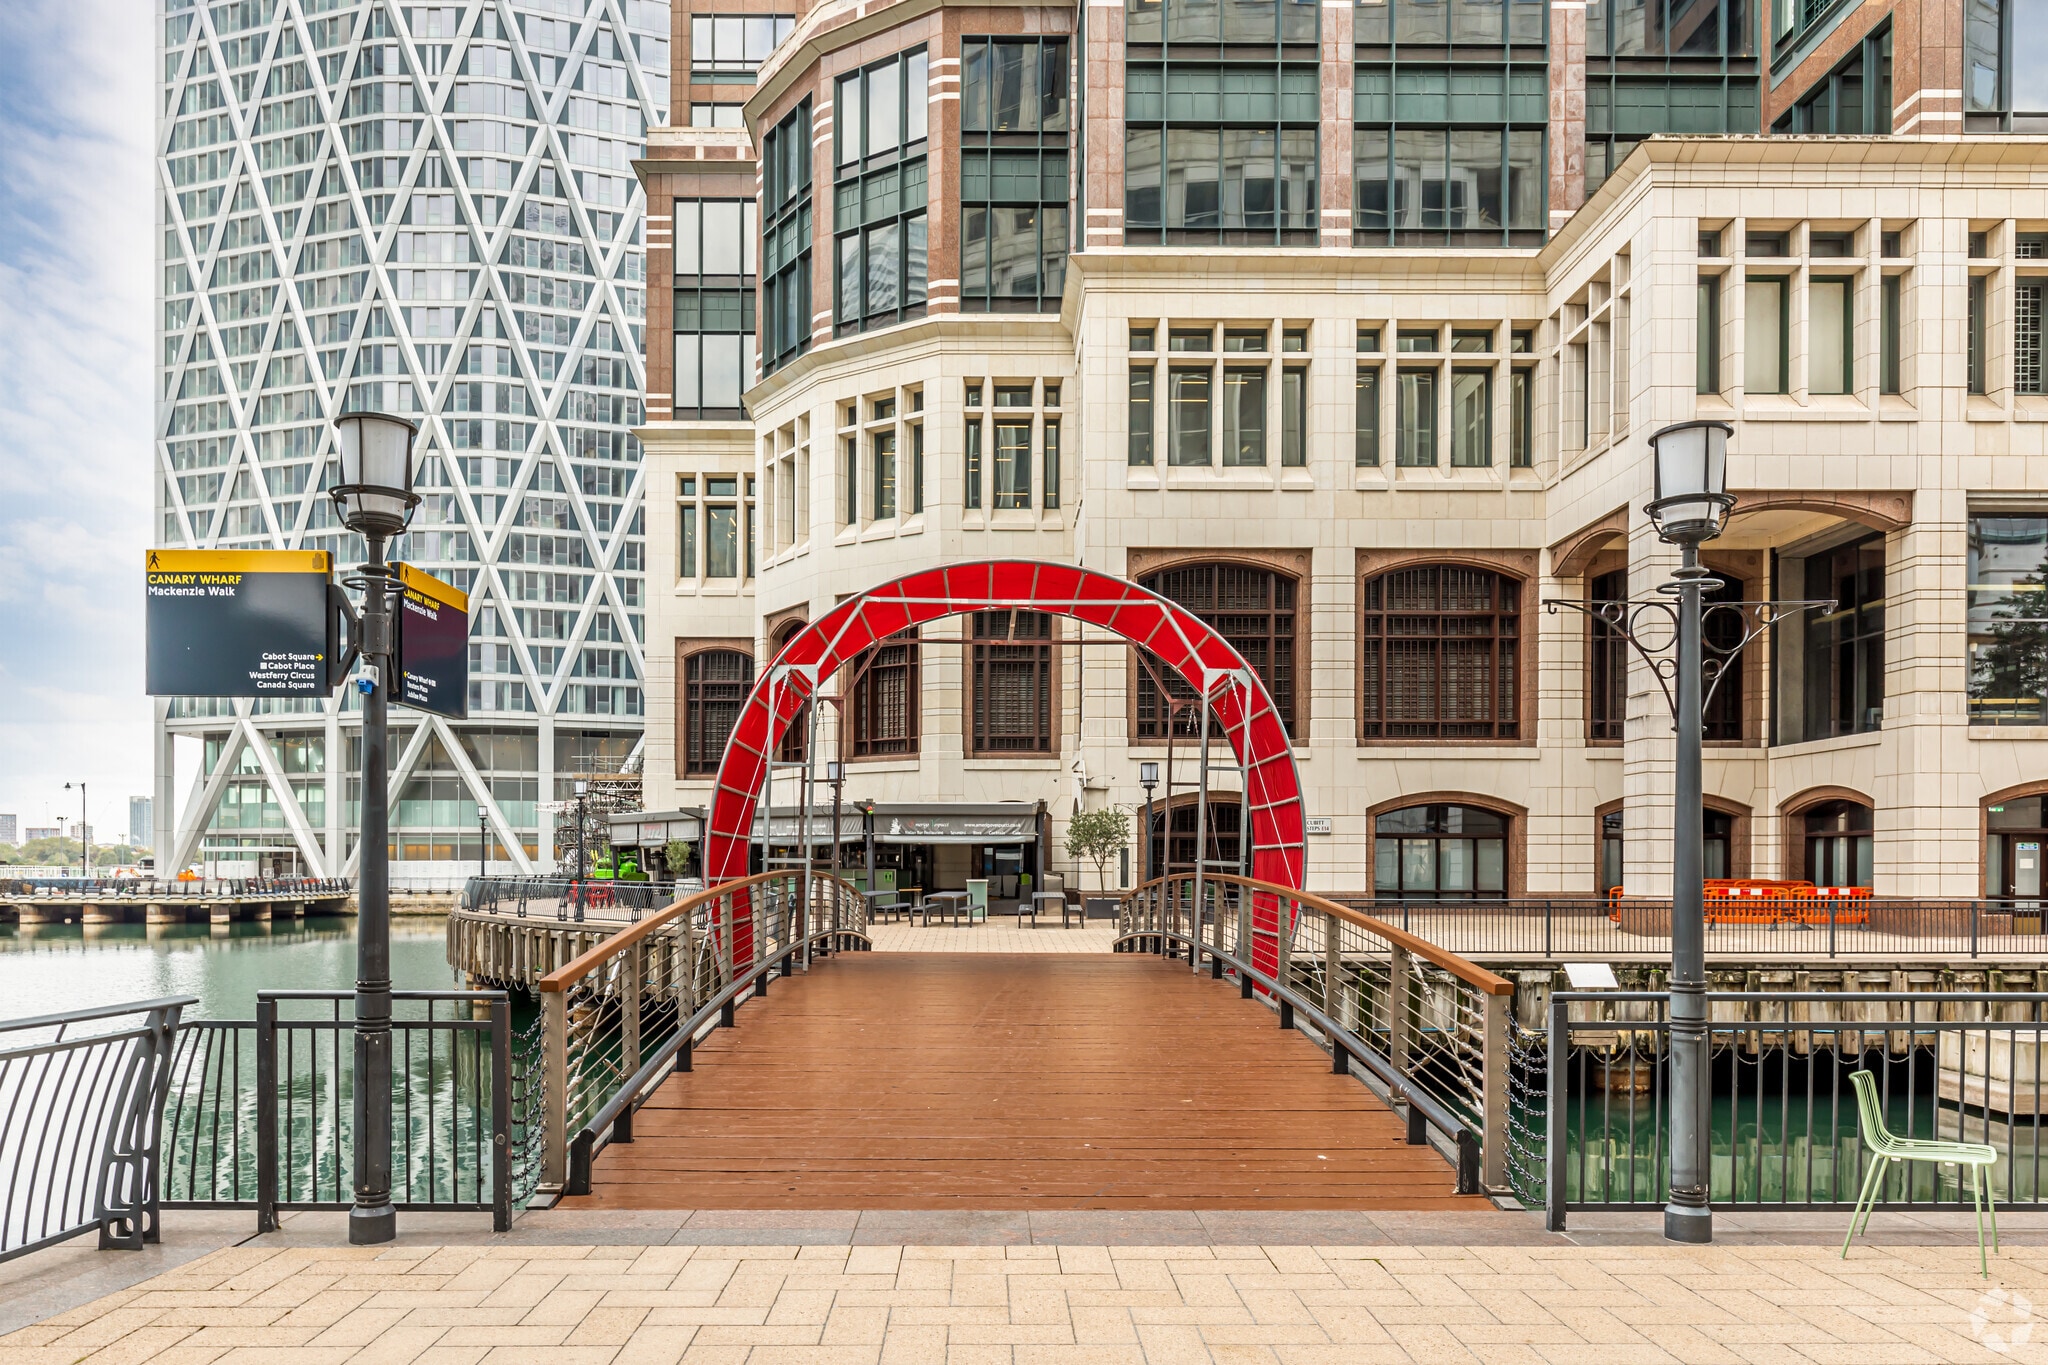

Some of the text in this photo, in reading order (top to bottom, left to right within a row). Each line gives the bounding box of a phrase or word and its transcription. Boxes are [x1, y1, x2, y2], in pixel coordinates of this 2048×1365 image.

[148, 574, 242, 584] CANARY WHARF
[148, 586, 236, 596] Mackenzie Walk
[404, 590, 440, 610] CANARY WHARF
[404, 598, 438, 621] Mackenzie Walk
[288, 653, 315, 661] Square
[249, 672, 288, 680] Westferry
[288, 681, 315, 690] Square
